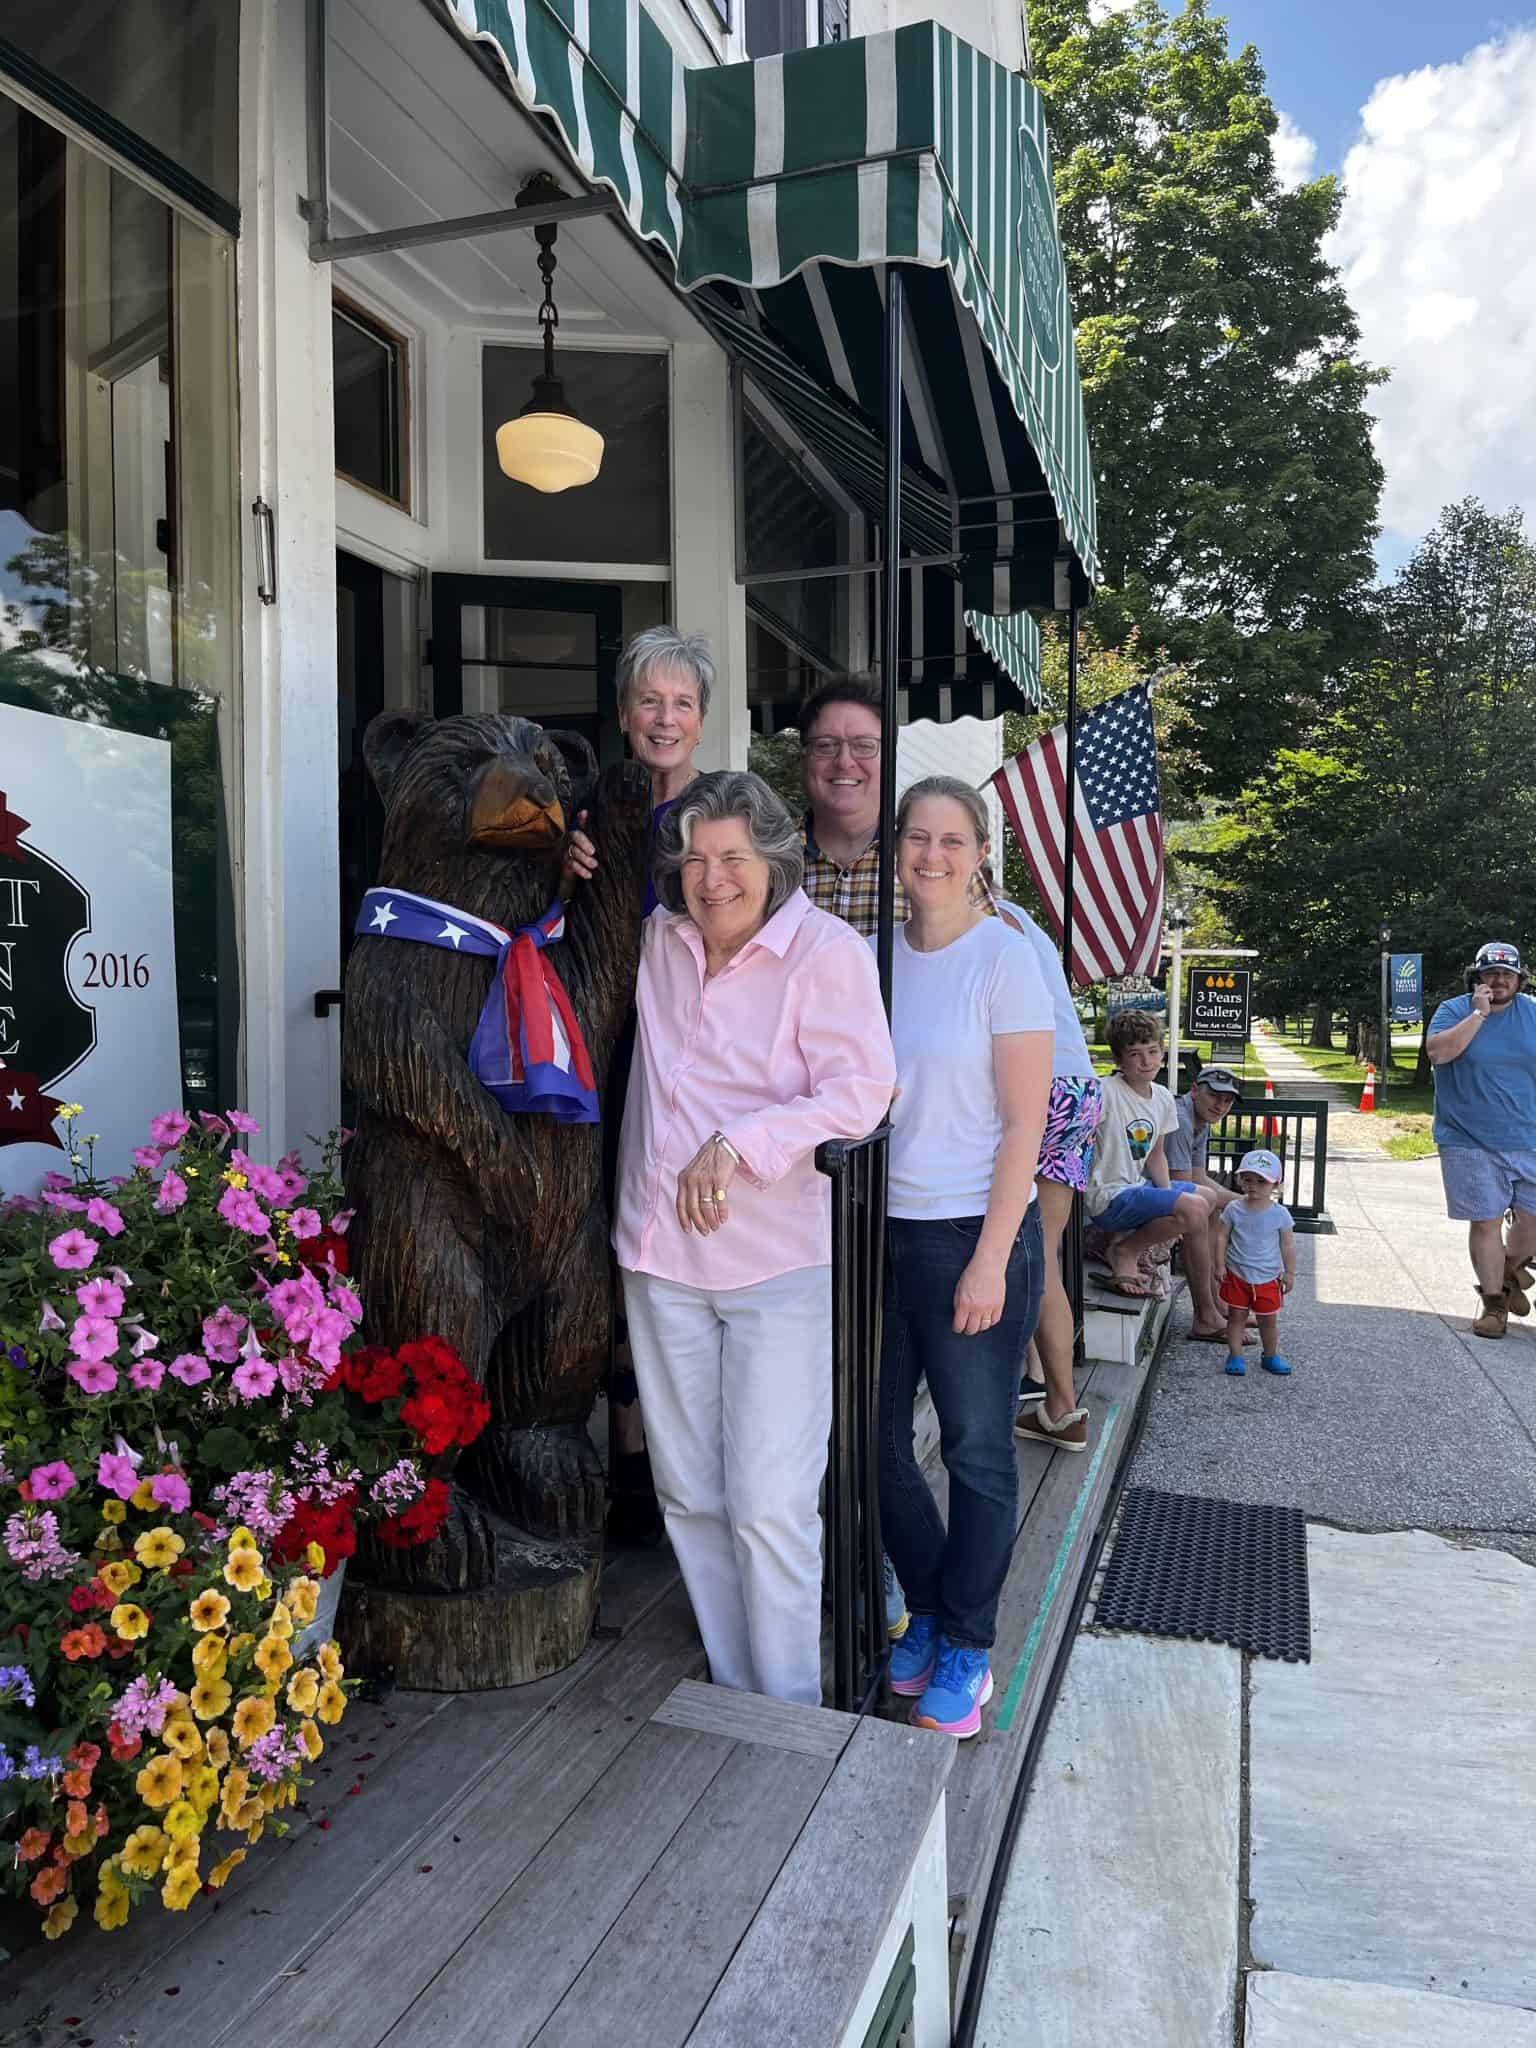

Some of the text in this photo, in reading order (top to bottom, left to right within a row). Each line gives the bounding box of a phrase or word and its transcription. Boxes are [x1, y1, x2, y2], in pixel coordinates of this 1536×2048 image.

[82, 952, 150, 988] 2016
[1197, 991, 1242, 1003] 3 Pears
[1195, 1005, 1242, 1021] Gallery
